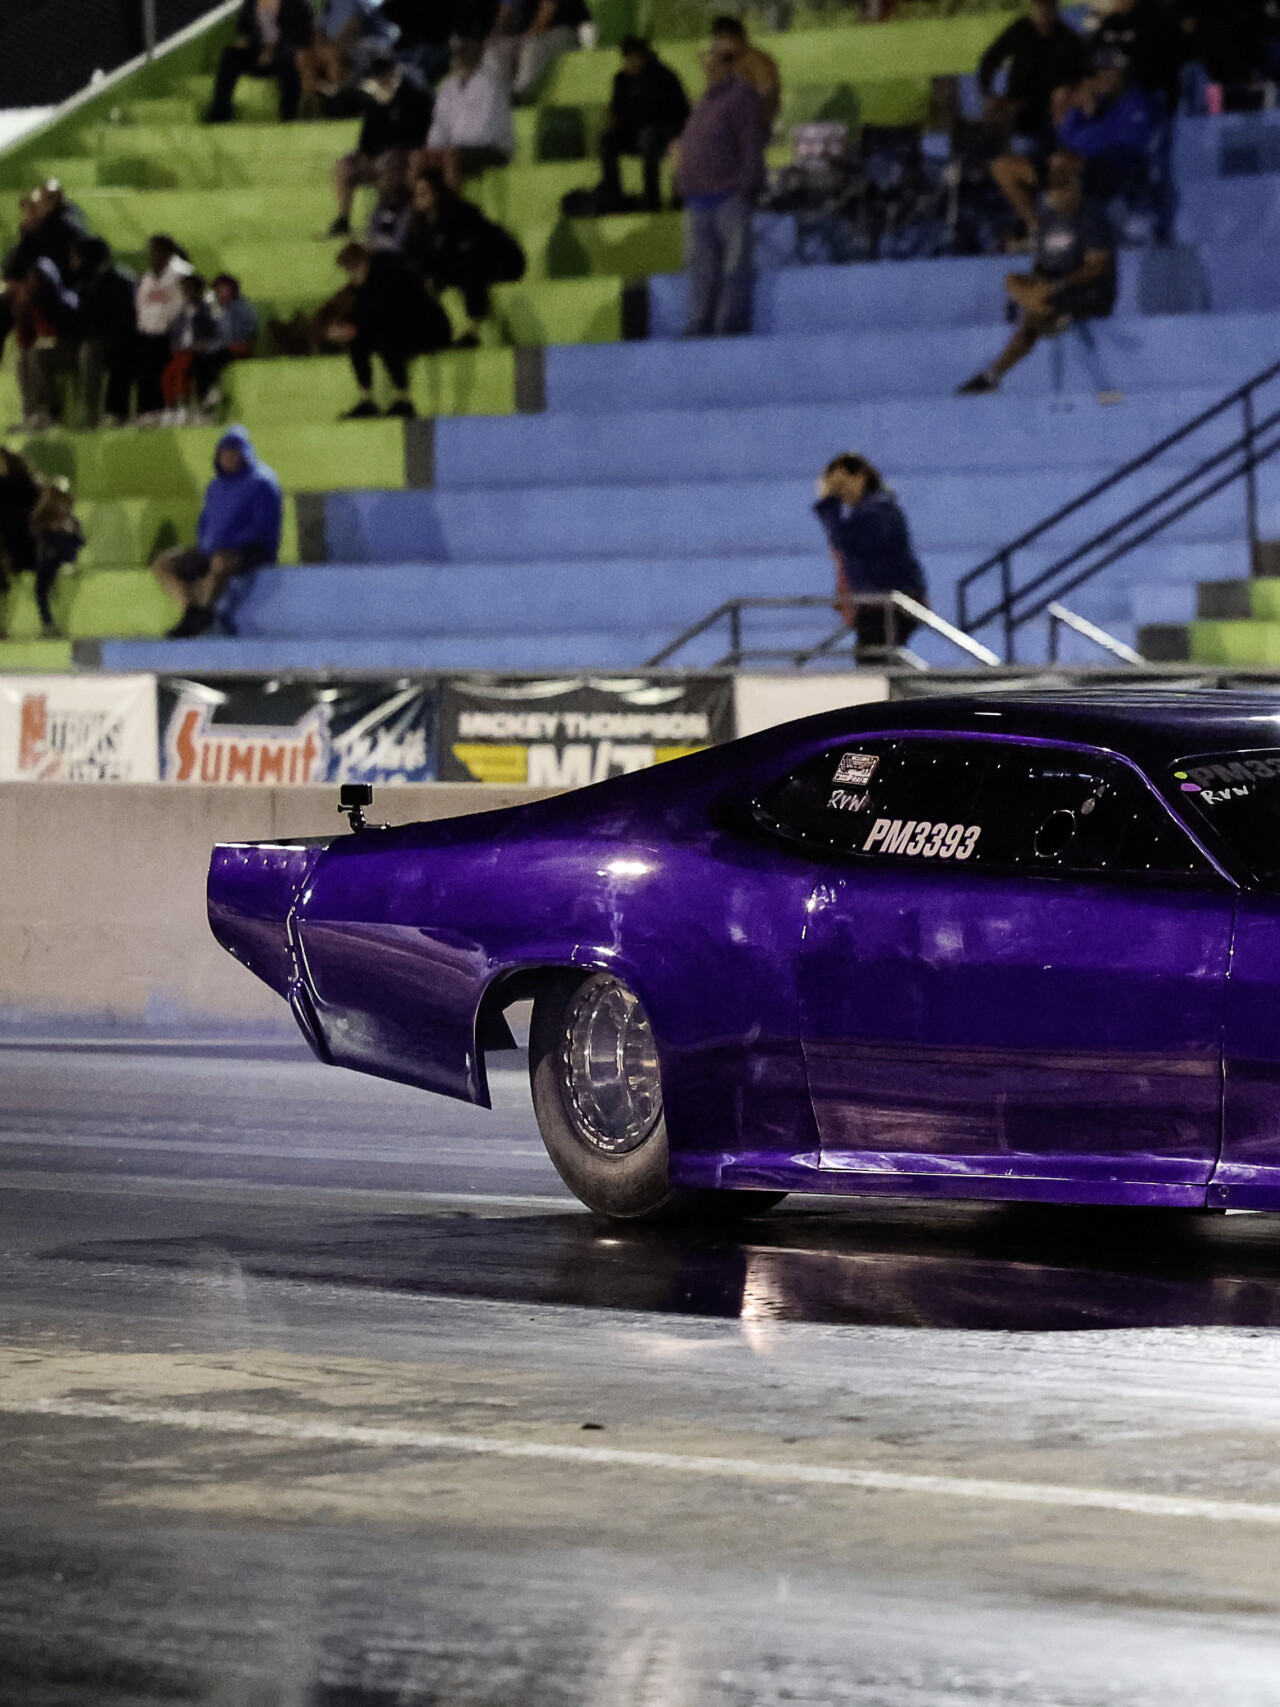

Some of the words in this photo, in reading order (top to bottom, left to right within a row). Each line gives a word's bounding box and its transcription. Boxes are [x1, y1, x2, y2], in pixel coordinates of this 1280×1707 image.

[174, 708, 318, 782] SUMMIT
[459, 712, 556, 738] MICKEY
[563, 712, 709, 739] THOMPSON
[863, 818, 982, 860] PM3393
